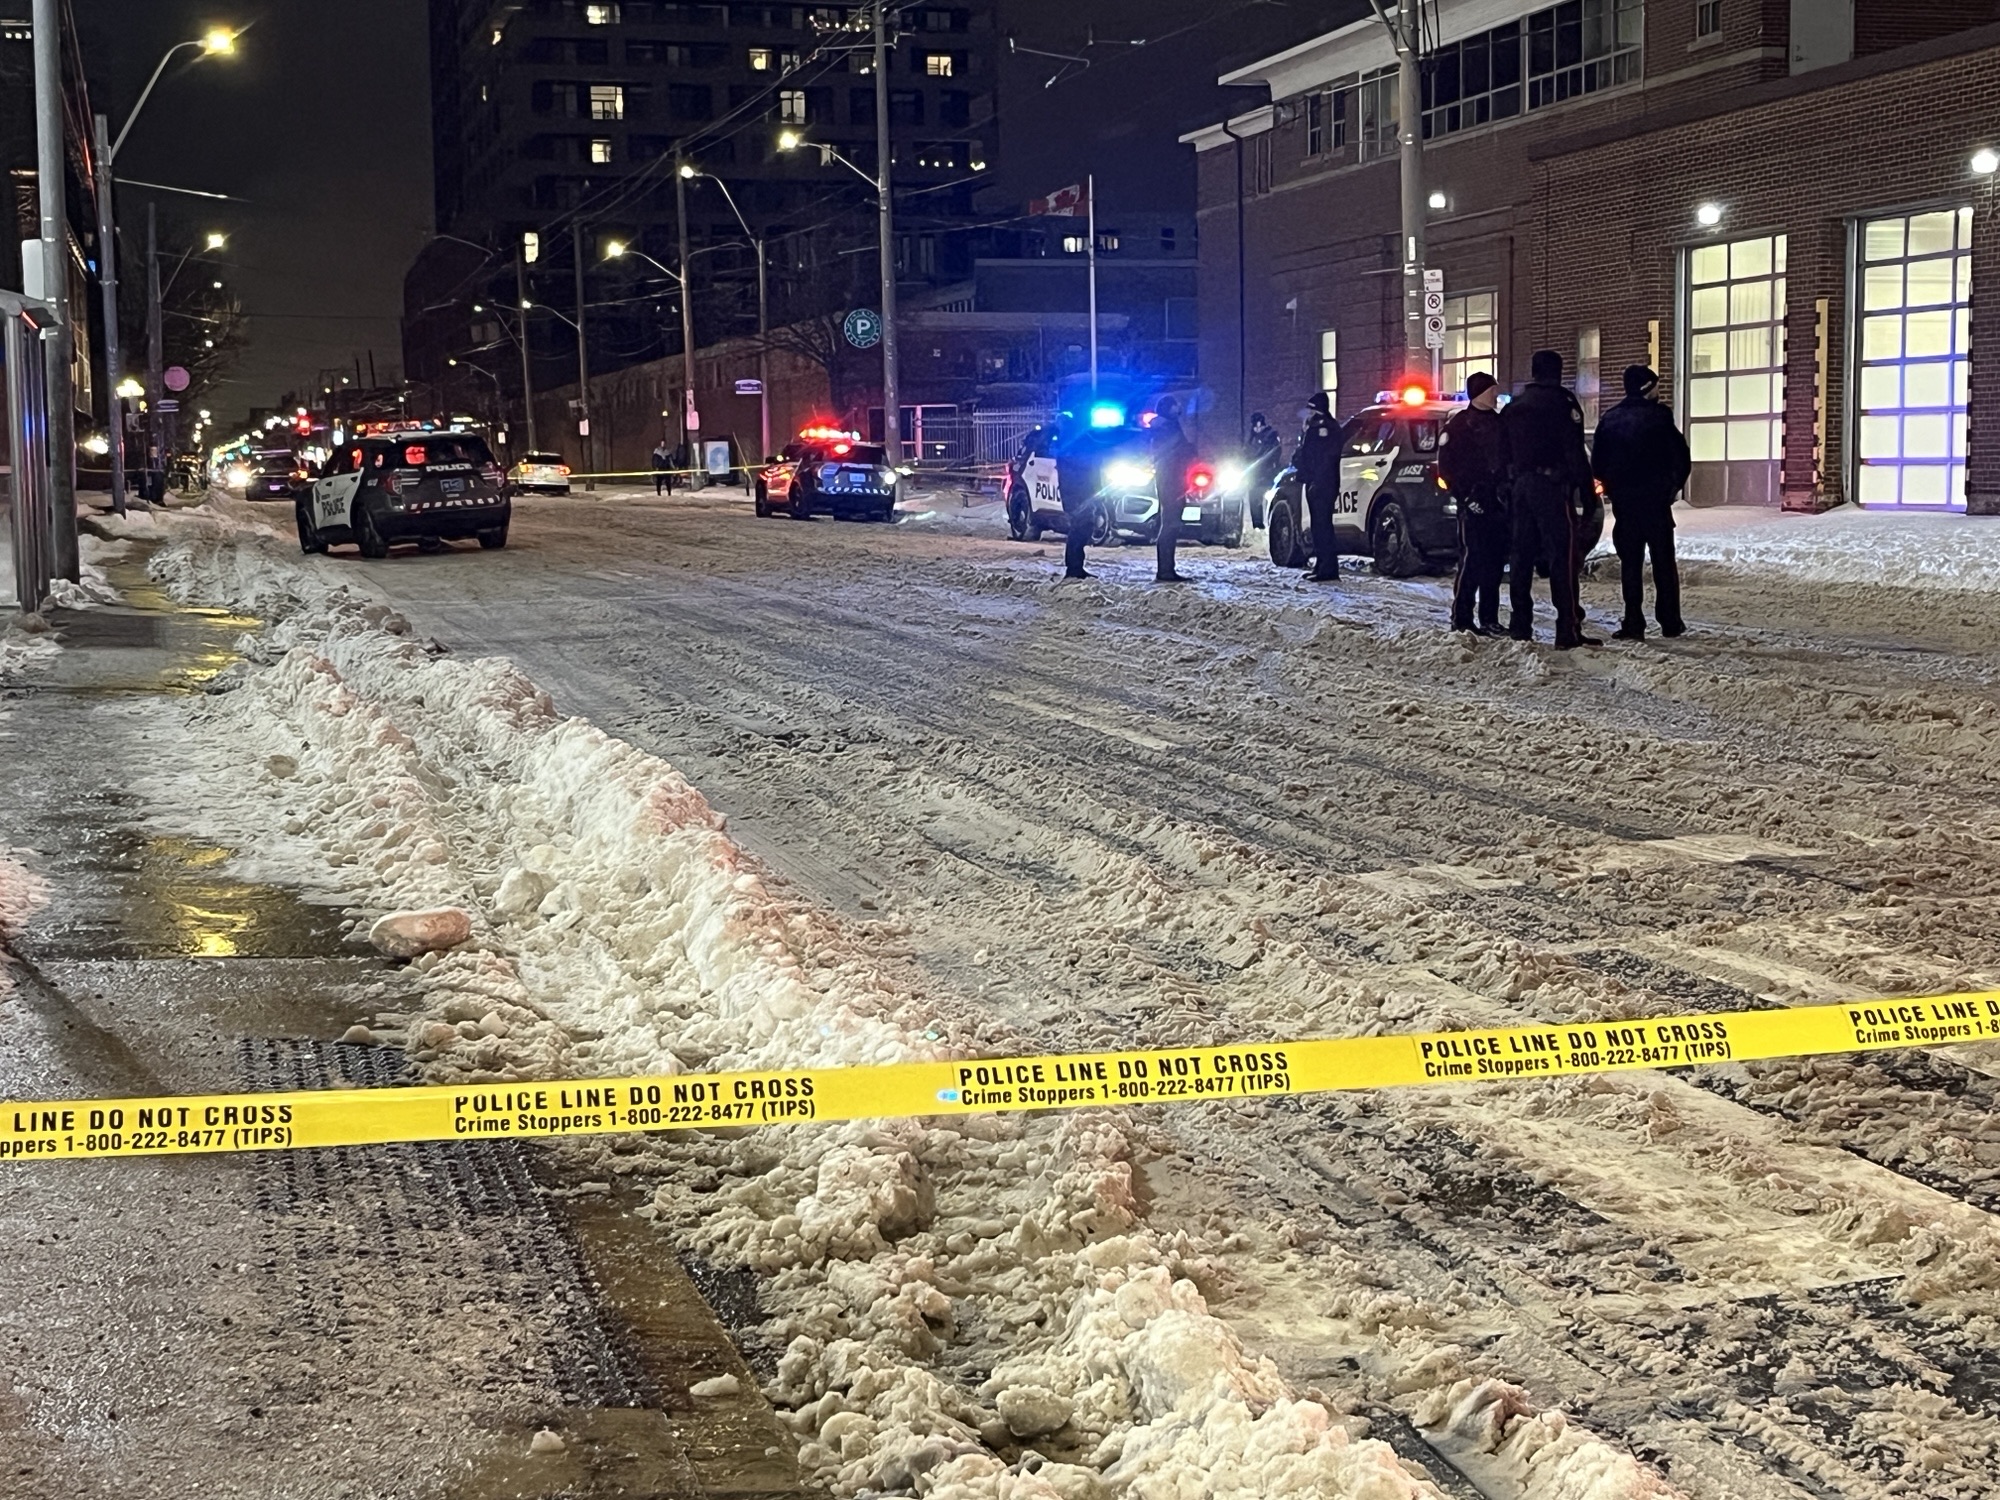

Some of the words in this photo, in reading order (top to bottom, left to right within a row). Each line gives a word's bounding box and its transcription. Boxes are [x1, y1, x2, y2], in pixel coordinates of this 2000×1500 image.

[856, 319, 871, 335] P
[426, 462, 473, 473] POLICE
[1849, 1005, 1926, 1027] POLICE
[1931, 1001, 1980, 1021] LINE
[1420, 1037, 1502, 1059] POLICE
[1509, 1033, 1560, 1053] LINE
[1567, 1031, 1597, 1050] DO
[1605, 1027, 1646, 1047] NOT
[1656, 1021, 1727, 1043] CROSS
[1855, 1029, 1900, 1044] Crime
[1904, 1024, 1971, 1041] Stoppers
[1975, 1019, 2000, 1035] 1-8
[959, 1065, 1045, 1087] POLICE
[1055, 1062, 1108, 1082] LINE
[1118, 1060, 1148, 1079] DO
[1158, 1057, 1201, 1077] NOT
[1213, 1052, 1288, 1074] CROSS
[1425, 1060, 1472, 1077] Crime
[1477, 1058, 1550, 1075] Stoppers
[1554, 1045, 1678, 1069] 1-800-222-8477
[1685, 1041, 1731, 1062] (TIPS)
[455, 1091, 548, 1114] POLICE
[561, 1088, 617, 1109] LINE
[629, 1085, 661, 1106] DO
[674, 1082, 720, 1103] NOT
[734, 1077, 814, 1100] CROSS
[962, 1088, 1012, 1106] Crime
[1018, 1086, 1095, 1105] Stoppers
[1101, 1076, 1234, 1099] 1-800-222-8477
[1241, 1072, 1290, 1094] (TIPS)
[14, 1111, 75, 1133] LINE
[90, 1109, 124, 1130] DO
[138, 1107, 190, 1129] NOT
[205, 1105, 292, 1127] CROSS
[455, 1116, 510, 1134] Crime
[518, 1113, 602, 1133] Stoppers
[608, 1102, 754, 1126] 1-800-222-8477
[761, 1099, 815, 1122] (TIPS)
[0, 1139, 57, 1158] ppers
[64, 1129, 226, 1152] 1-800-222-8477
[233, 1127, 292, 1149] (TIPS)
